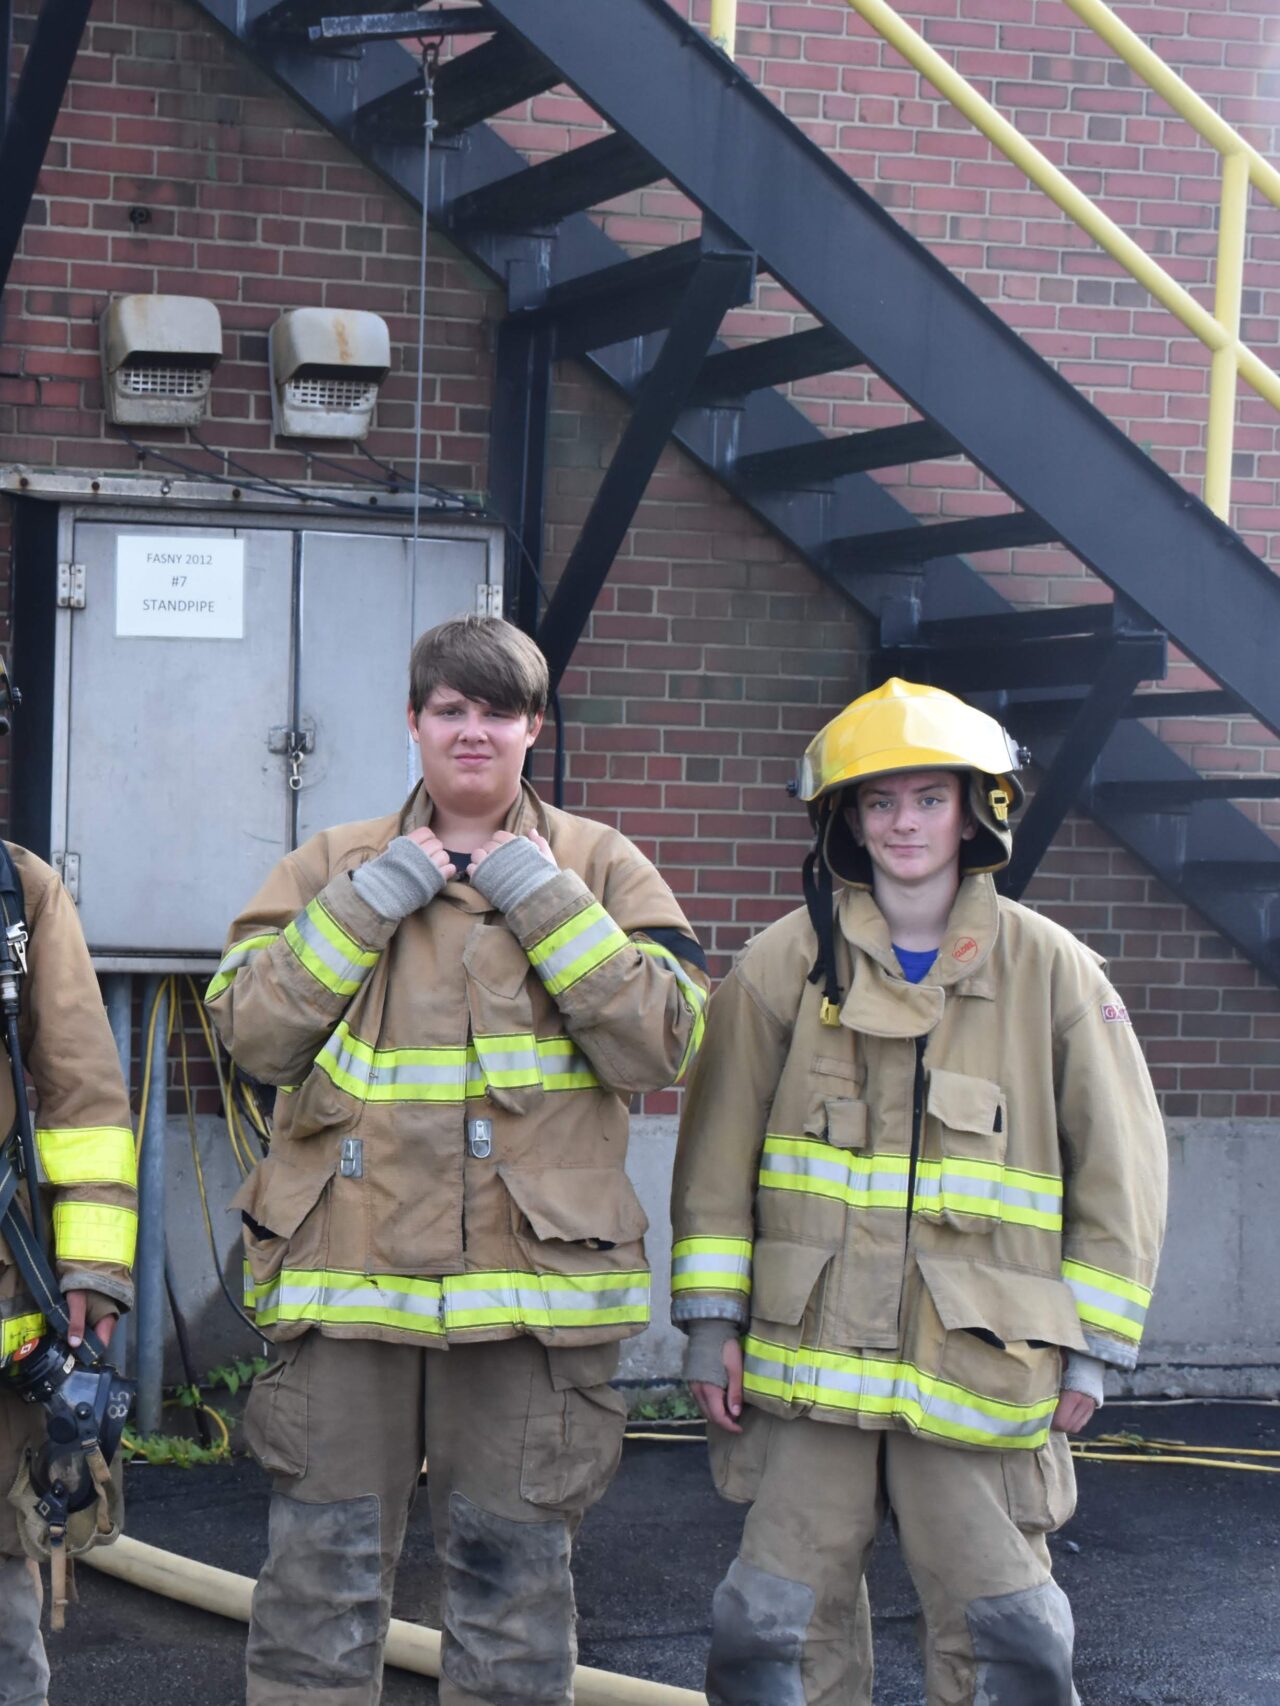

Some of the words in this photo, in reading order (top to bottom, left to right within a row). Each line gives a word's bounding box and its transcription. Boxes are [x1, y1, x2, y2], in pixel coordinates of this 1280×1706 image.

[146, 552, 182, 564] FASNY
[185, 553, 213, 565] 2012
[170, 575, 187, 587] #7
[143, 599, 215, 612] STANDPIPE
[108, 1391, 129, 1419] 85
